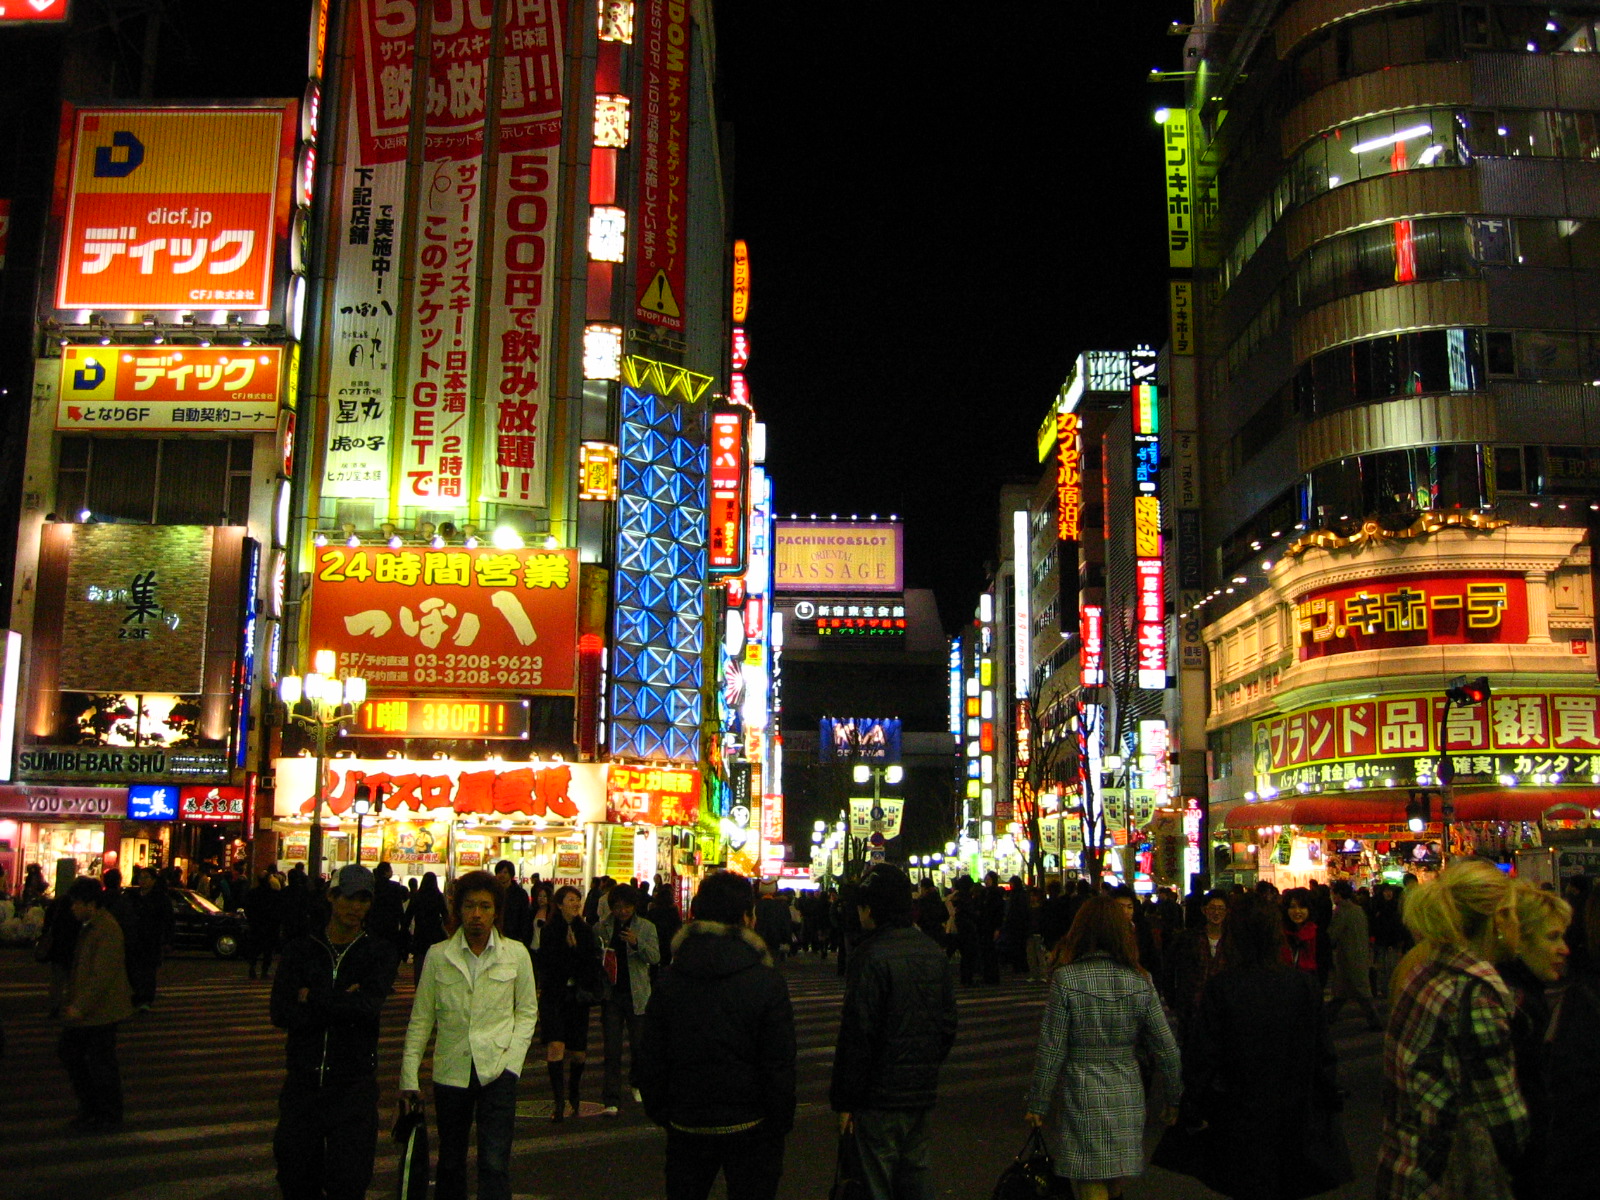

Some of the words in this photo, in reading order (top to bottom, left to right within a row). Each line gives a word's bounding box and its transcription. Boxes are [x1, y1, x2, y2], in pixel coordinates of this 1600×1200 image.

[667, 0, 685, 72] DOM
[349, 168, 375, 245] 下記店舗
[147, 207, 213, 228] dicf.jp
[81, 226, 255, 275] ディック
[190, 289, 213, 300] CFJ
[215, 289, 255, 300] 株式会社
[340, 301, 393, 317] つぼ八
[636, 308, 660, 322] STOP!
[661, 315, 681, 328] AIDS
[497, 155, 548, 500] 500円で飲み放題!!
[134, 357, 256, 392] ディック
[84, 406, 150, 422] となり6F
[171, 405, 276, 423] 自動契約コーナー
[329, 435, 386, 452] 虎の子
[1136, 447, 1146, 461] de
[1147, 442, 1157, 473] Castle
[1057, 413, 1080, 541] カプセル宿泊料
[1136, 462, 1147, 481] Elle
[1182, 465, 1193, 506] TRAVEL
[777, 536, 887, 546] PACHINKO&SLOT
[811, 549, 854, 562] ORIENTAL
[320, 551, 570, 589] 24時間営業
[778, 562, 887, 579] PASSAGE
[344, 590, 538, 649] つぼ八
[414, 654, 543, 671] 03-3208-9623
[413, 670, 543, 686] 03-3208-9625
[19, 752, 124, 773] SUMIBI-BAR
[614, 770, 693, 793] マンガ喫茶
[27, 796, 61, 812] YOU
[76, 797, 111, 813] YOU
